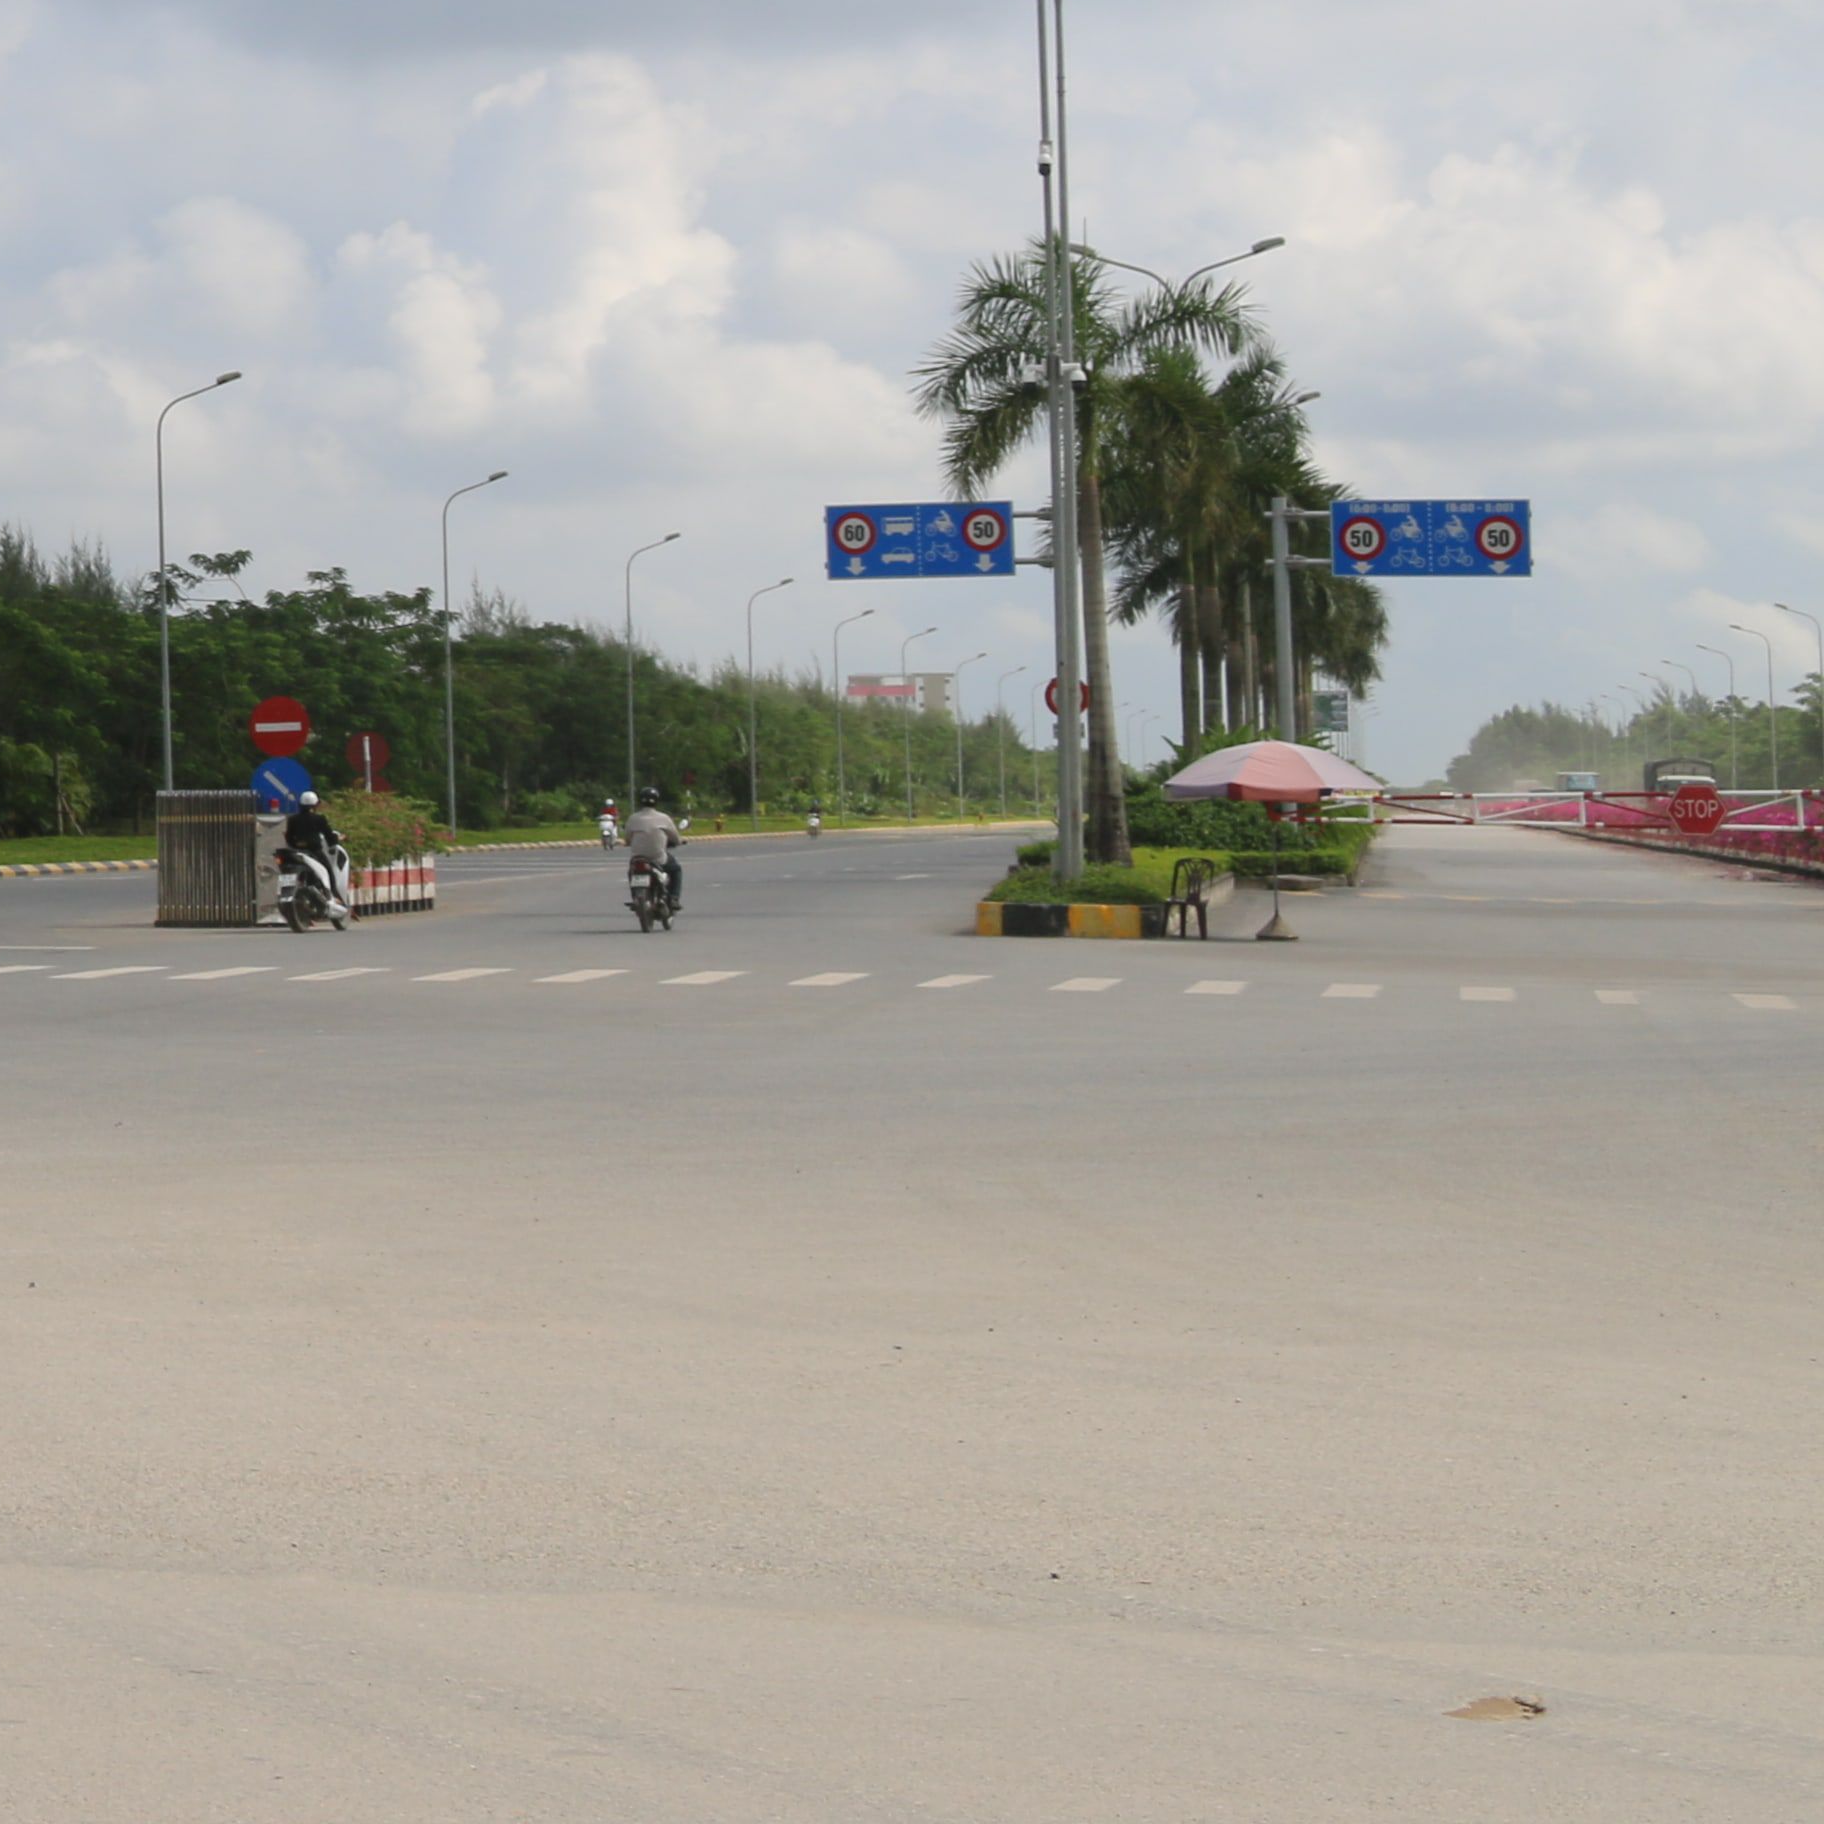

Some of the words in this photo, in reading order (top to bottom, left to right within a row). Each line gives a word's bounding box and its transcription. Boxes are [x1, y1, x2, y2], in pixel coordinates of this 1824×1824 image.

[844, 524, 865, 542] 60
[972, 521, 994, 539] 50
[1350, 529, 1373, 548] 50
[1487, 529, 1510, 548] 50
[1674, 800, 1718, 818] STOP
